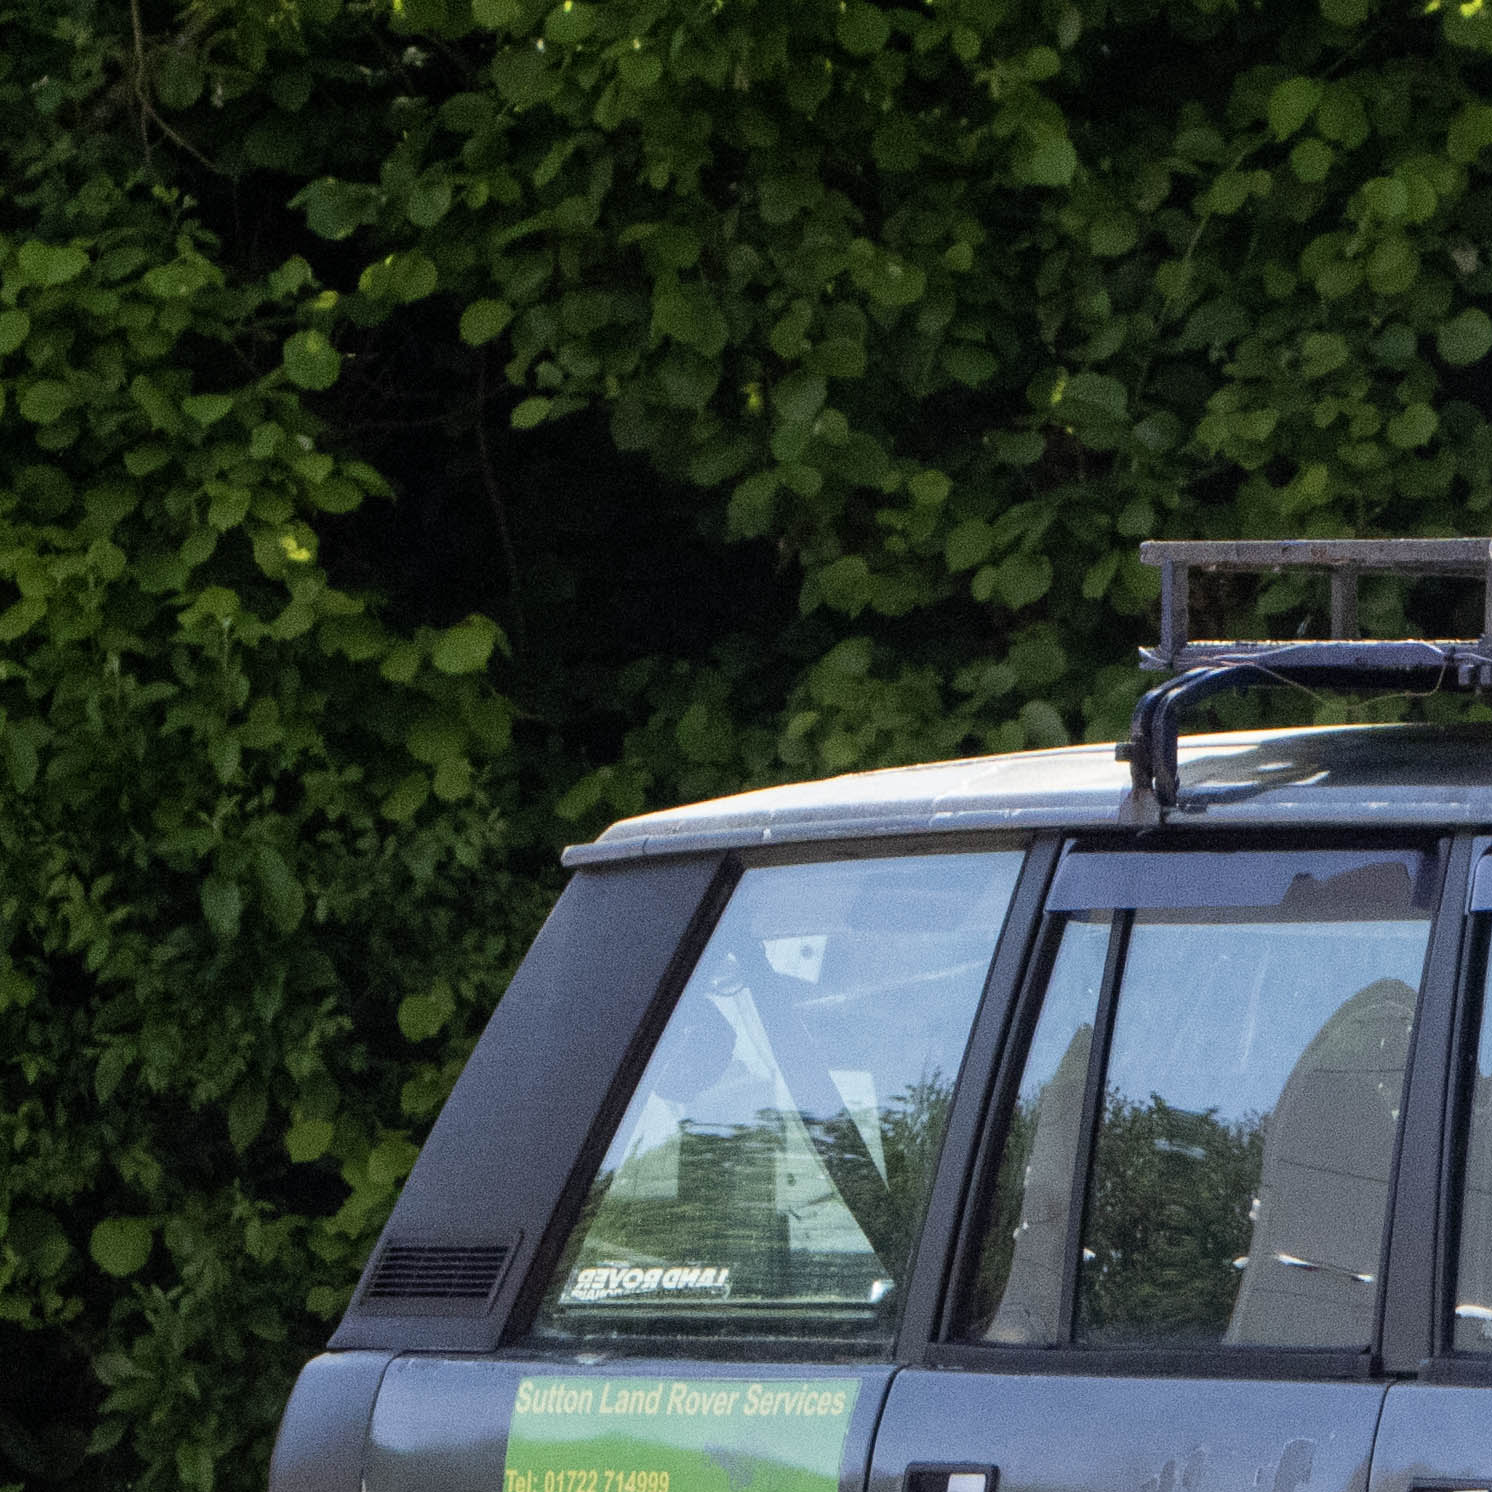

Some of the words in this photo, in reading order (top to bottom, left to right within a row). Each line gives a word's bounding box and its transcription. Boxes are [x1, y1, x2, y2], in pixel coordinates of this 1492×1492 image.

[515, 1379, 593, 1415] Sutton
[598, 1382, 663, 1416] Land
[666, 1383, 737, 1416] Rover
[743, 1384, 846, 1417] Services
